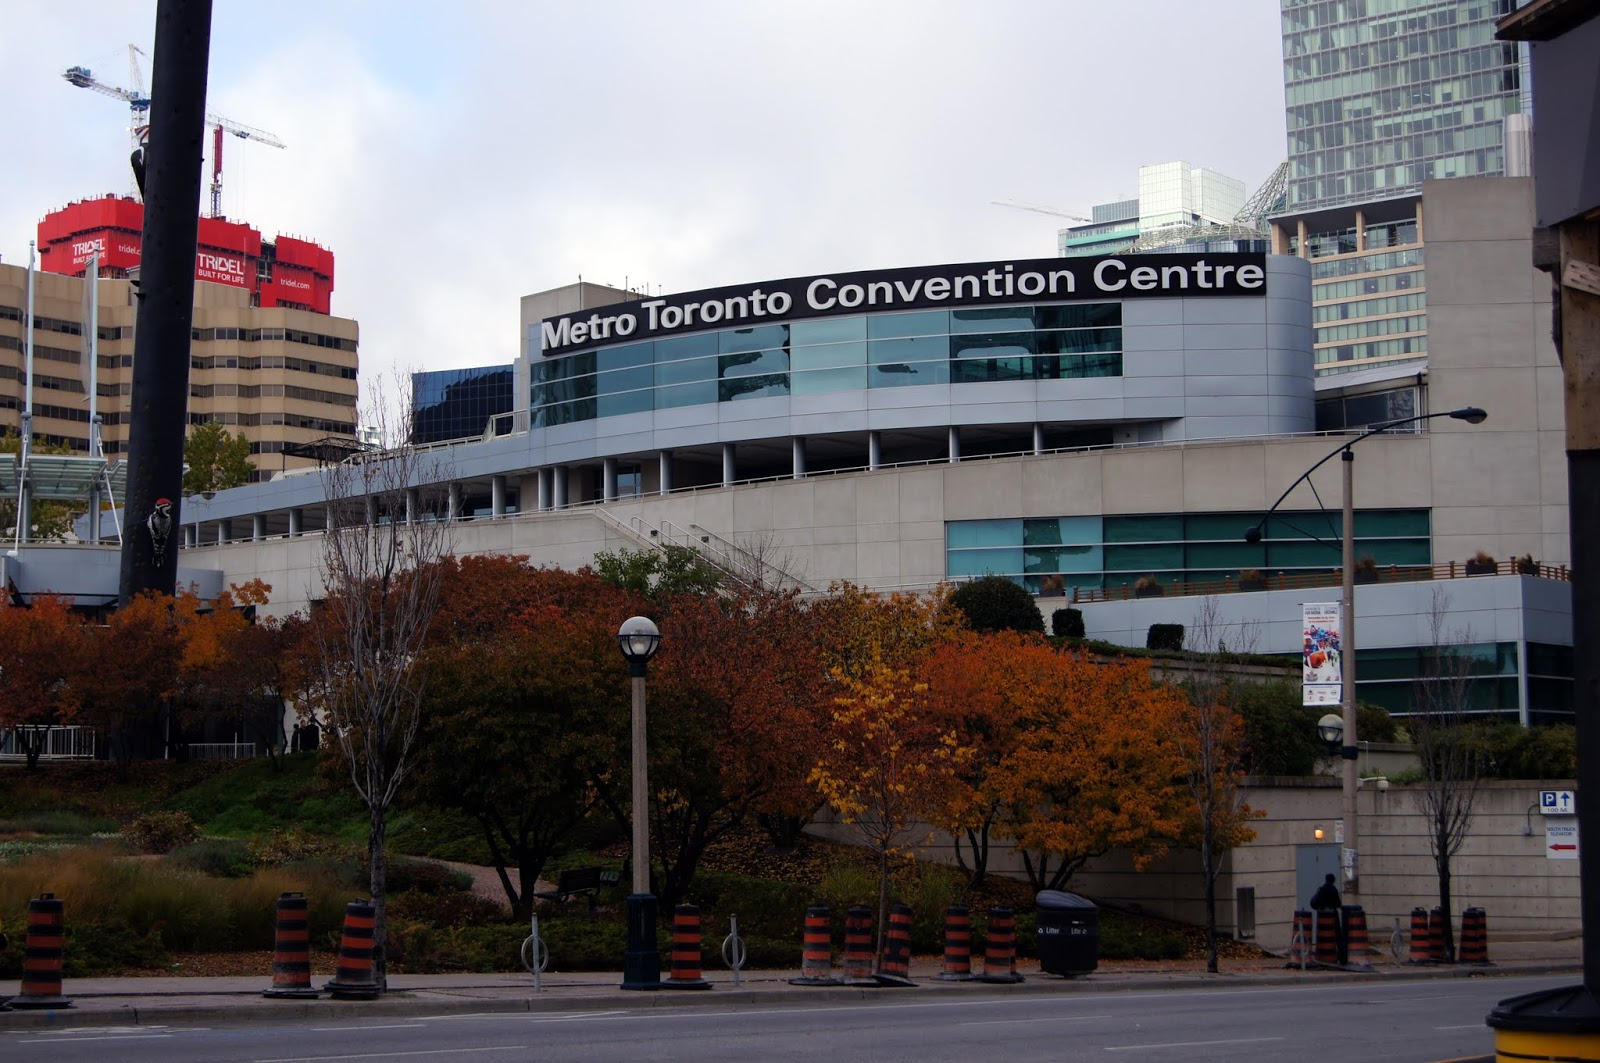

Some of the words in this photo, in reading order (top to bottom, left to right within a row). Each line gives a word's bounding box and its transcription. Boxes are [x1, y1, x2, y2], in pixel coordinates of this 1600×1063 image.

[118, 245, 141, 255] tridel.c
[197, 253, 243, 275] TRIDEL
[198, 269, 216, 279] BUILT
[218, 273, 231, 281] FOR
[232, 276, 244, 284] LIFE
[280, 279, 310, 289] tridel.com
[541, 312, 637, 350] Metro
[641, 288, 793, 330] Toronto
[806, 264, 1075, 311] Convention
[1093, 259, 1265, 292] Centre
[1545, 794, 1554, 805] P
